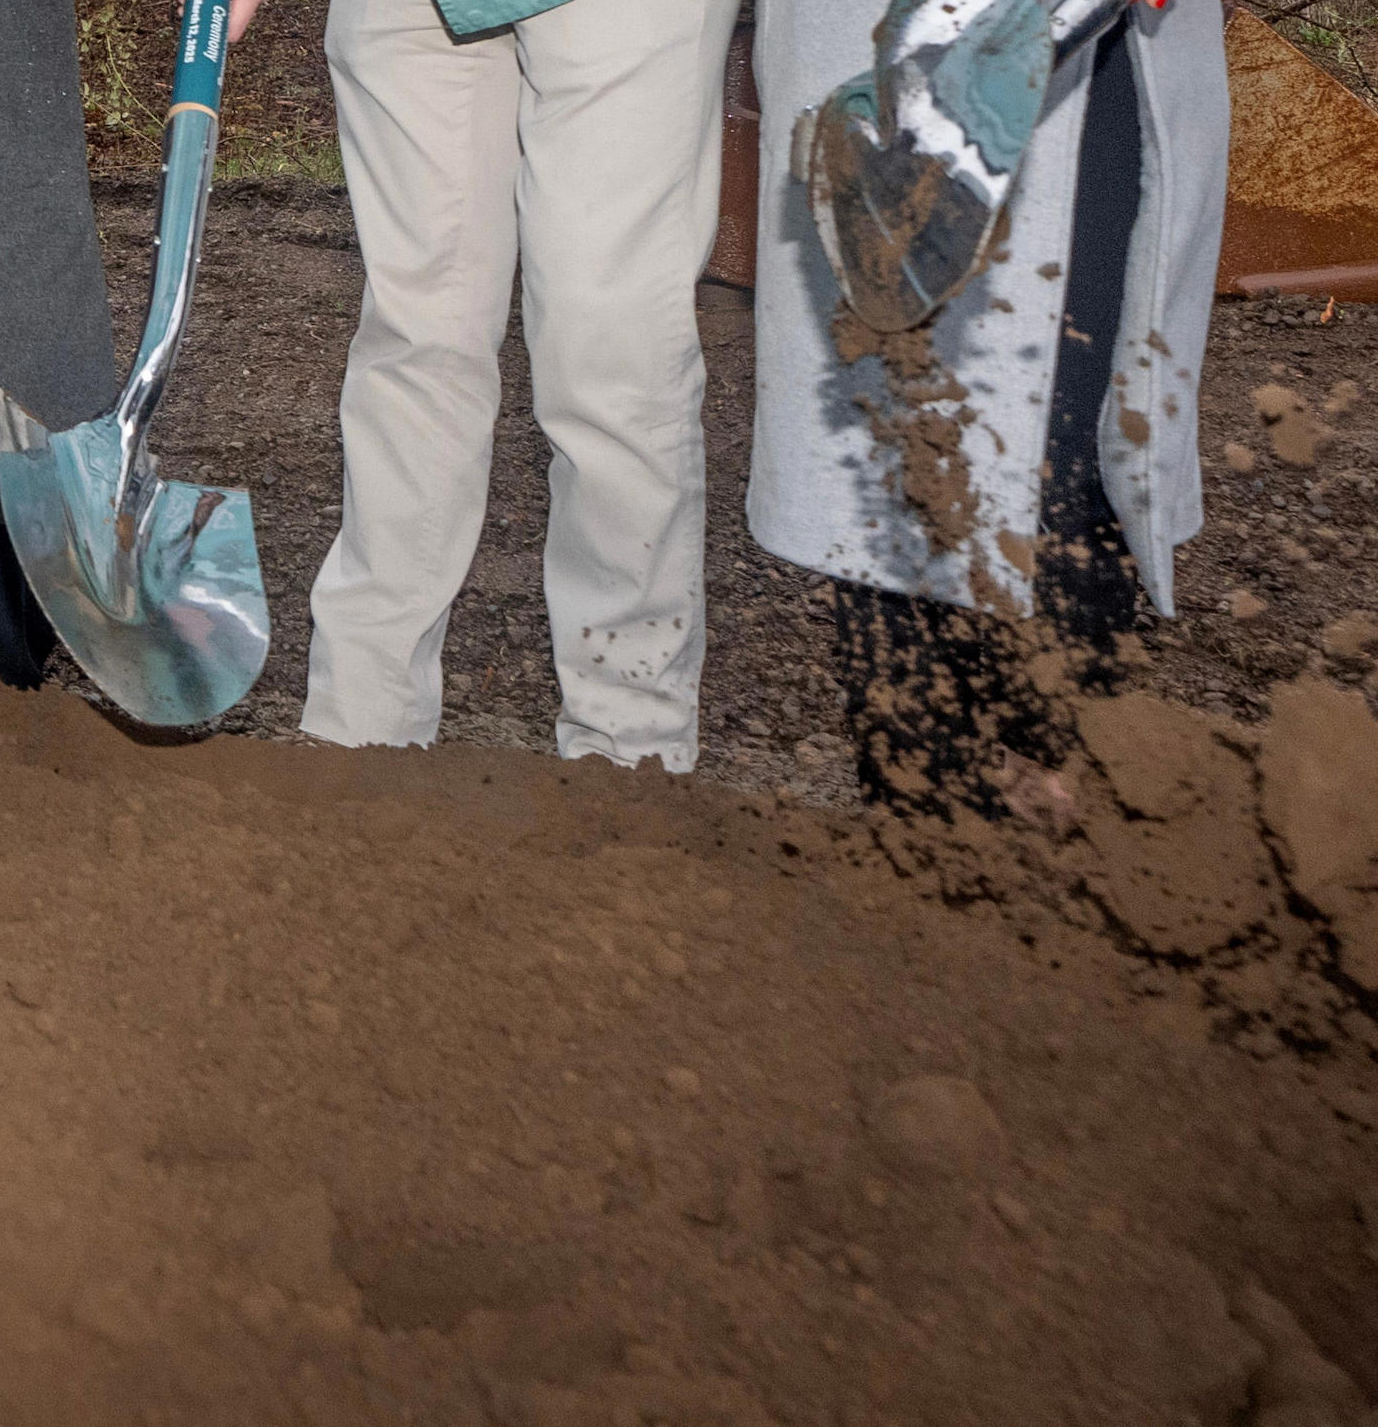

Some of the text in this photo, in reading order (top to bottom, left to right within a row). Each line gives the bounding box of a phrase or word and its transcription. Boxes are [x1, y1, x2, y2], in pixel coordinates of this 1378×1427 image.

[187, 24, 200, 38] 12,
[203, 5, 226, 63] Ceremony
[184, 38, 197, 63] 2025
